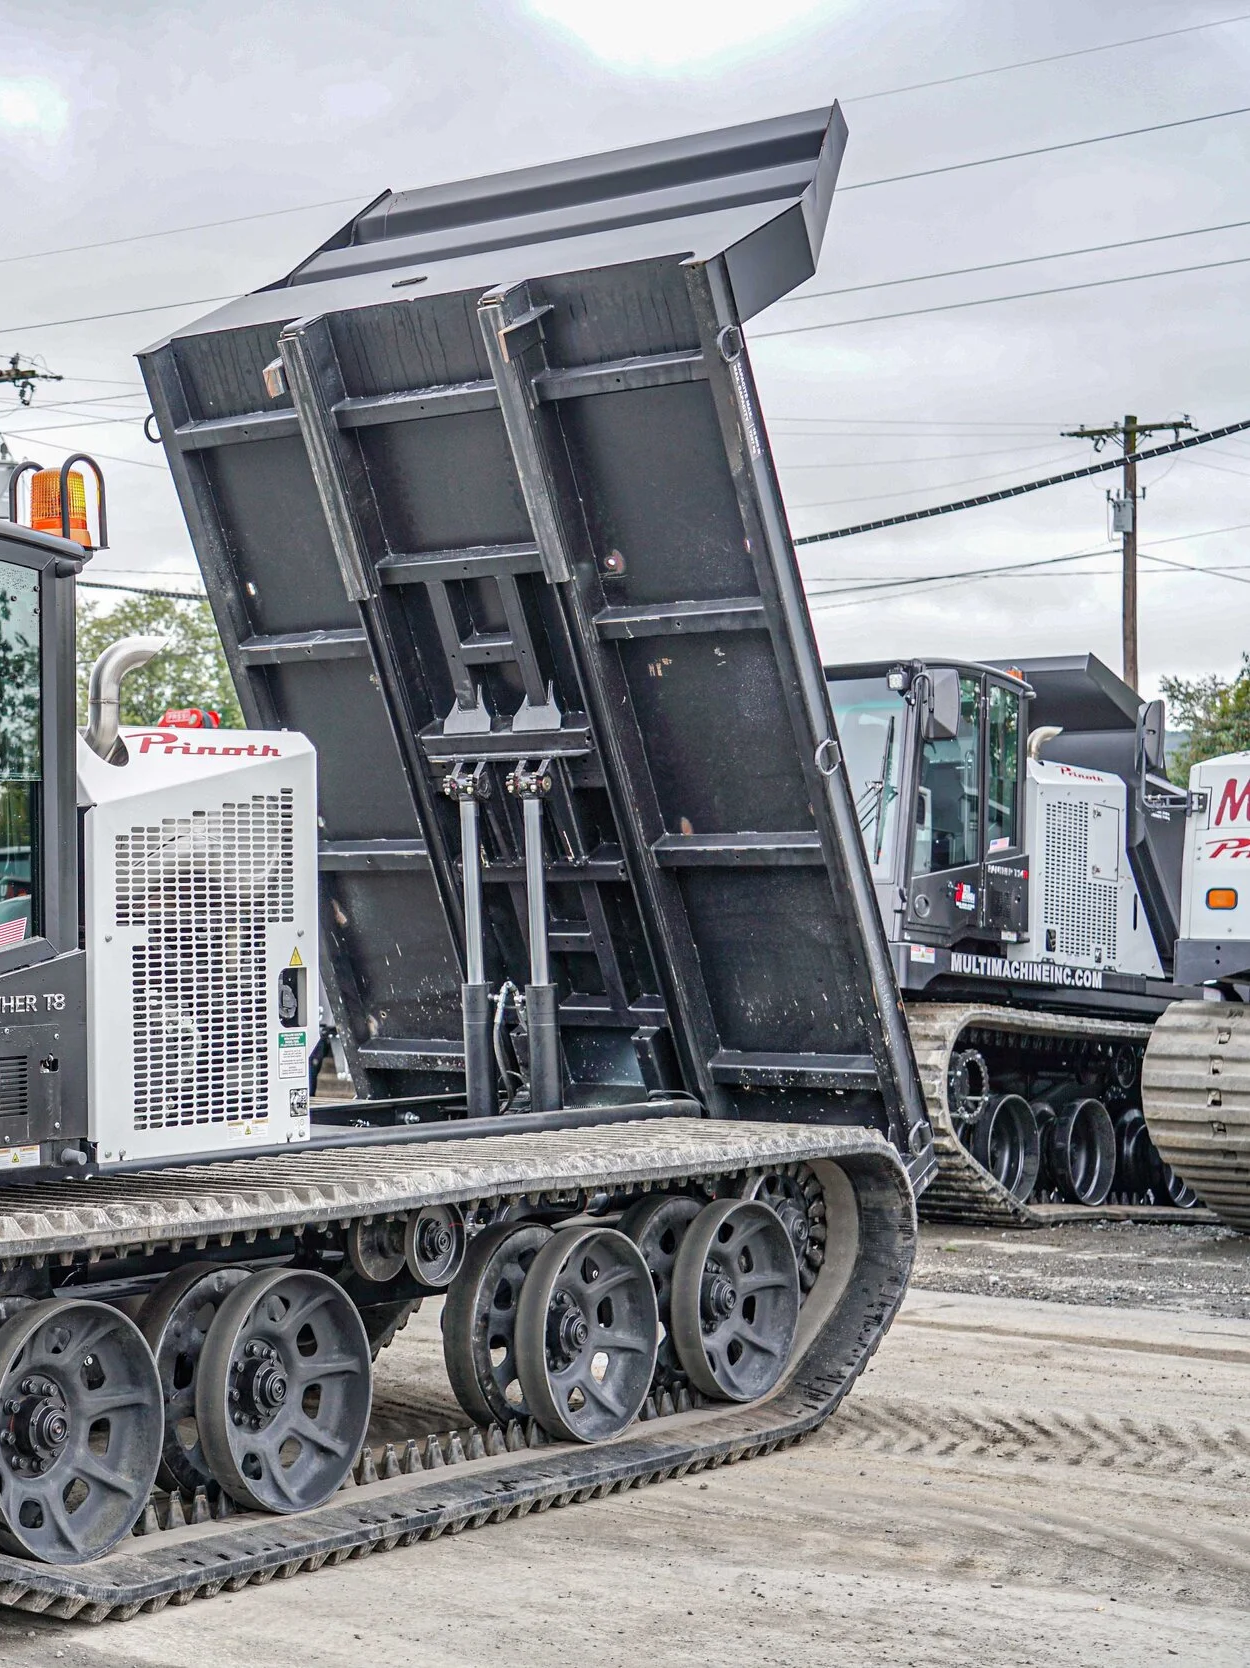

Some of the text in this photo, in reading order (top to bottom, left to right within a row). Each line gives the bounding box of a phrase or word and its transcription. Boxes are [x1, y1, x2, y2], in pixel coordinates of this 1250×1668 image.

[125, 732, 282, 757] Prinoth
[1055, 765, 1104, 782] Prinoth
[1205, 837, 1250, 858] Pr
[950, 952, 1103, 989] MULTIMACHINEINC.COM
[43, 993, 66, 1011] T8
